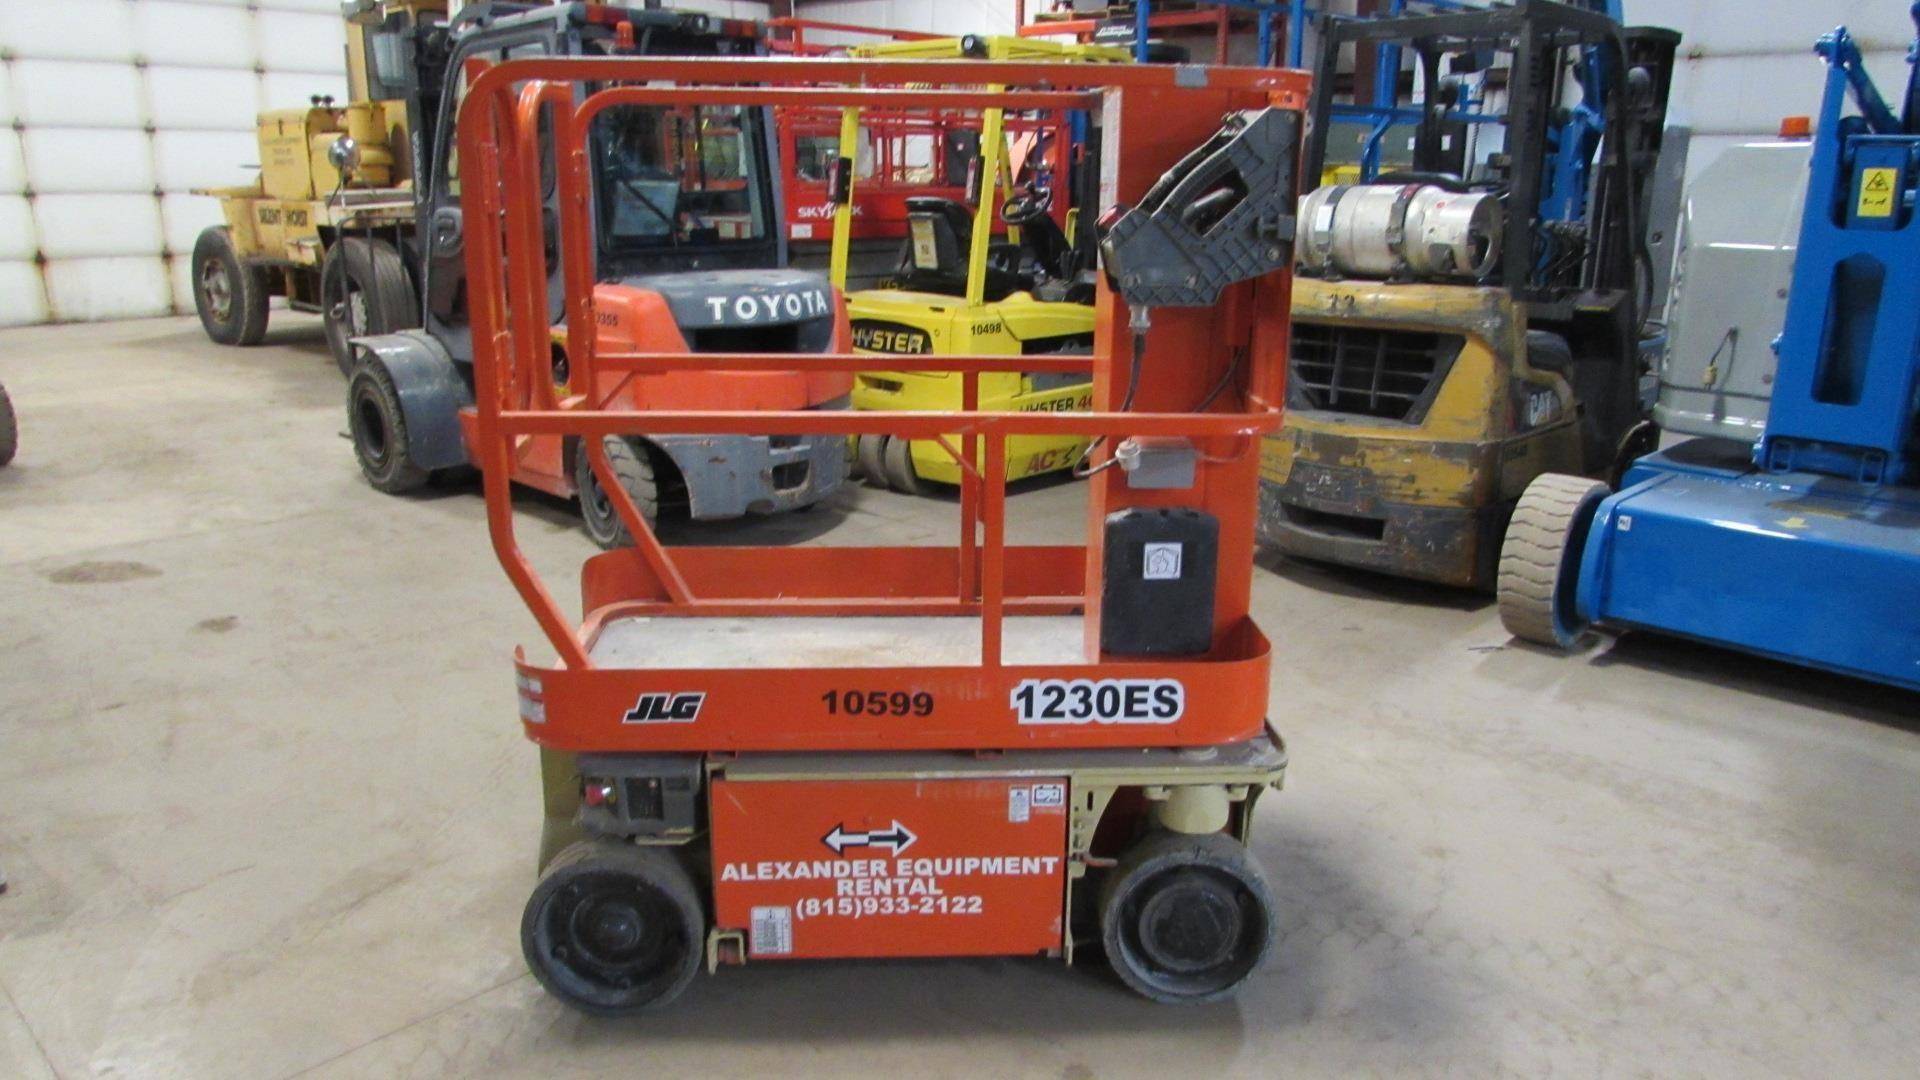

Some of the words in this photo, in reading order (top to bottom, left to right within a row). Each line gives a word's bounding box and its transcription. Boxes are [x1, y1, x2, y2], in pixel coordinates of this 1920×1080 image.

[798, 202, 863, 219] SKYJK
[707, 290, 827, 321] TOYOTA
[852, 328, 924, 354] HYSTER
[971, 323, 1001, 336] 10498
[623, 692, 705, 722] JLG
[822, 690, 934, 716] 10599
[1013, 682, 1181, 722] 1230ES
[720, 858, 888, 881] ALEXANDER
[896, 856, 1059, 877] EQUIPMENT
[836, 878, 944, 896] RENTAL
[795, 896, 983, 920] (815)933-2122
